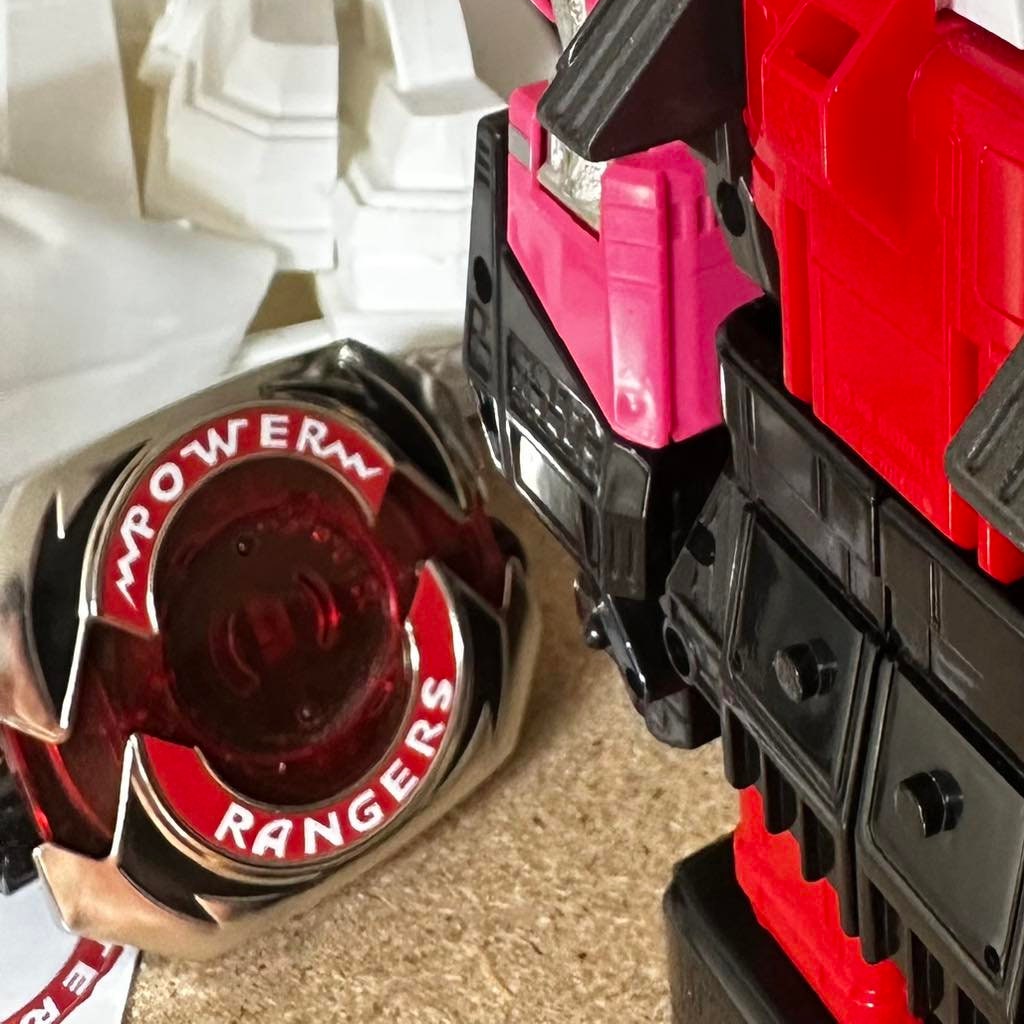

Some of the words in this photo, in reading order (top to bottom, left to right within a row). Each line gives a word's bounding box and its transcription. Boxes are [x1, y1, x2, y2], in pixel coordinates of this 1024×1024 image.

[116, 413, 381, 608] POWER
[214, 676, 454, 858] RANGERS
[19, 942, 112, 1024] ER
